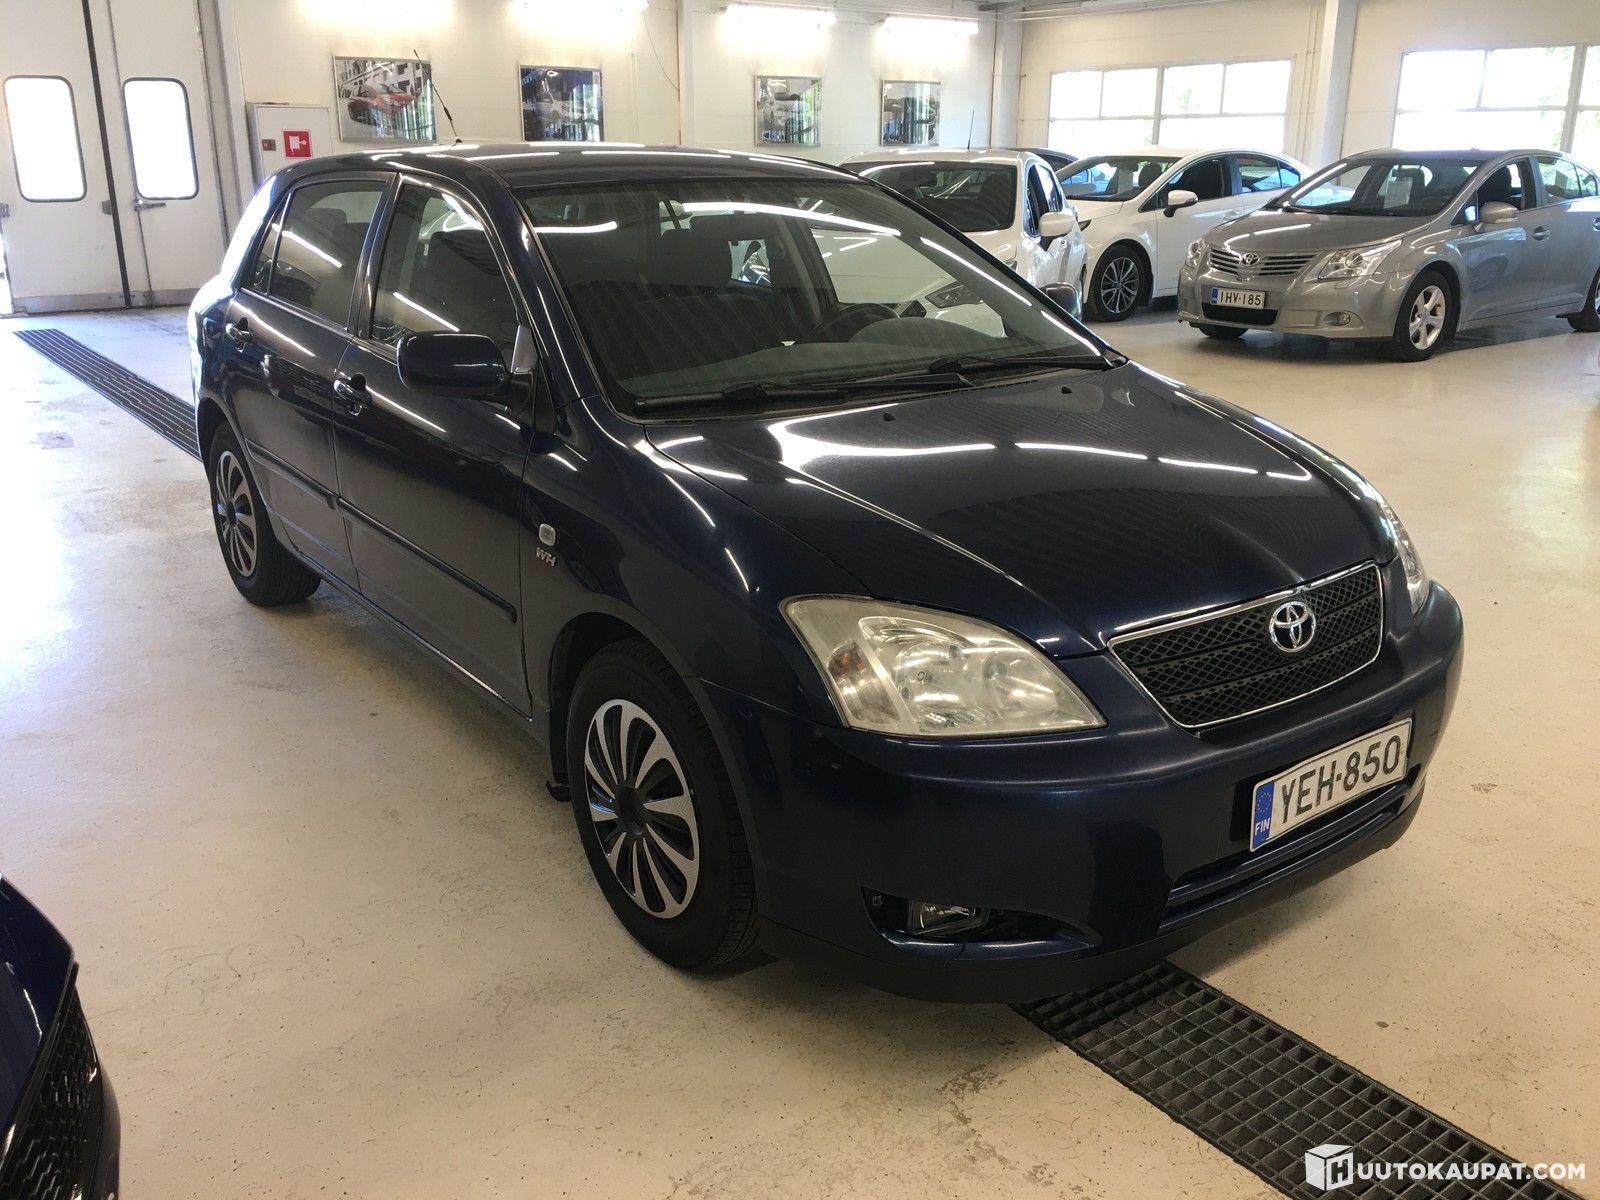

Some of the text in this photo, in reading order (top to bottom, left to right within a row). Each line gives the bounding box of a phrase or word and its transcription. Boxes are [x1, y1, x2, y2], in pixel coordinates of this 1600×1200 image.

[1220, 291, 1261, 306] IHV-185
[1281, 735, 1401, 824] YEH-850
[1254, 818, 1271, 836] FIN
